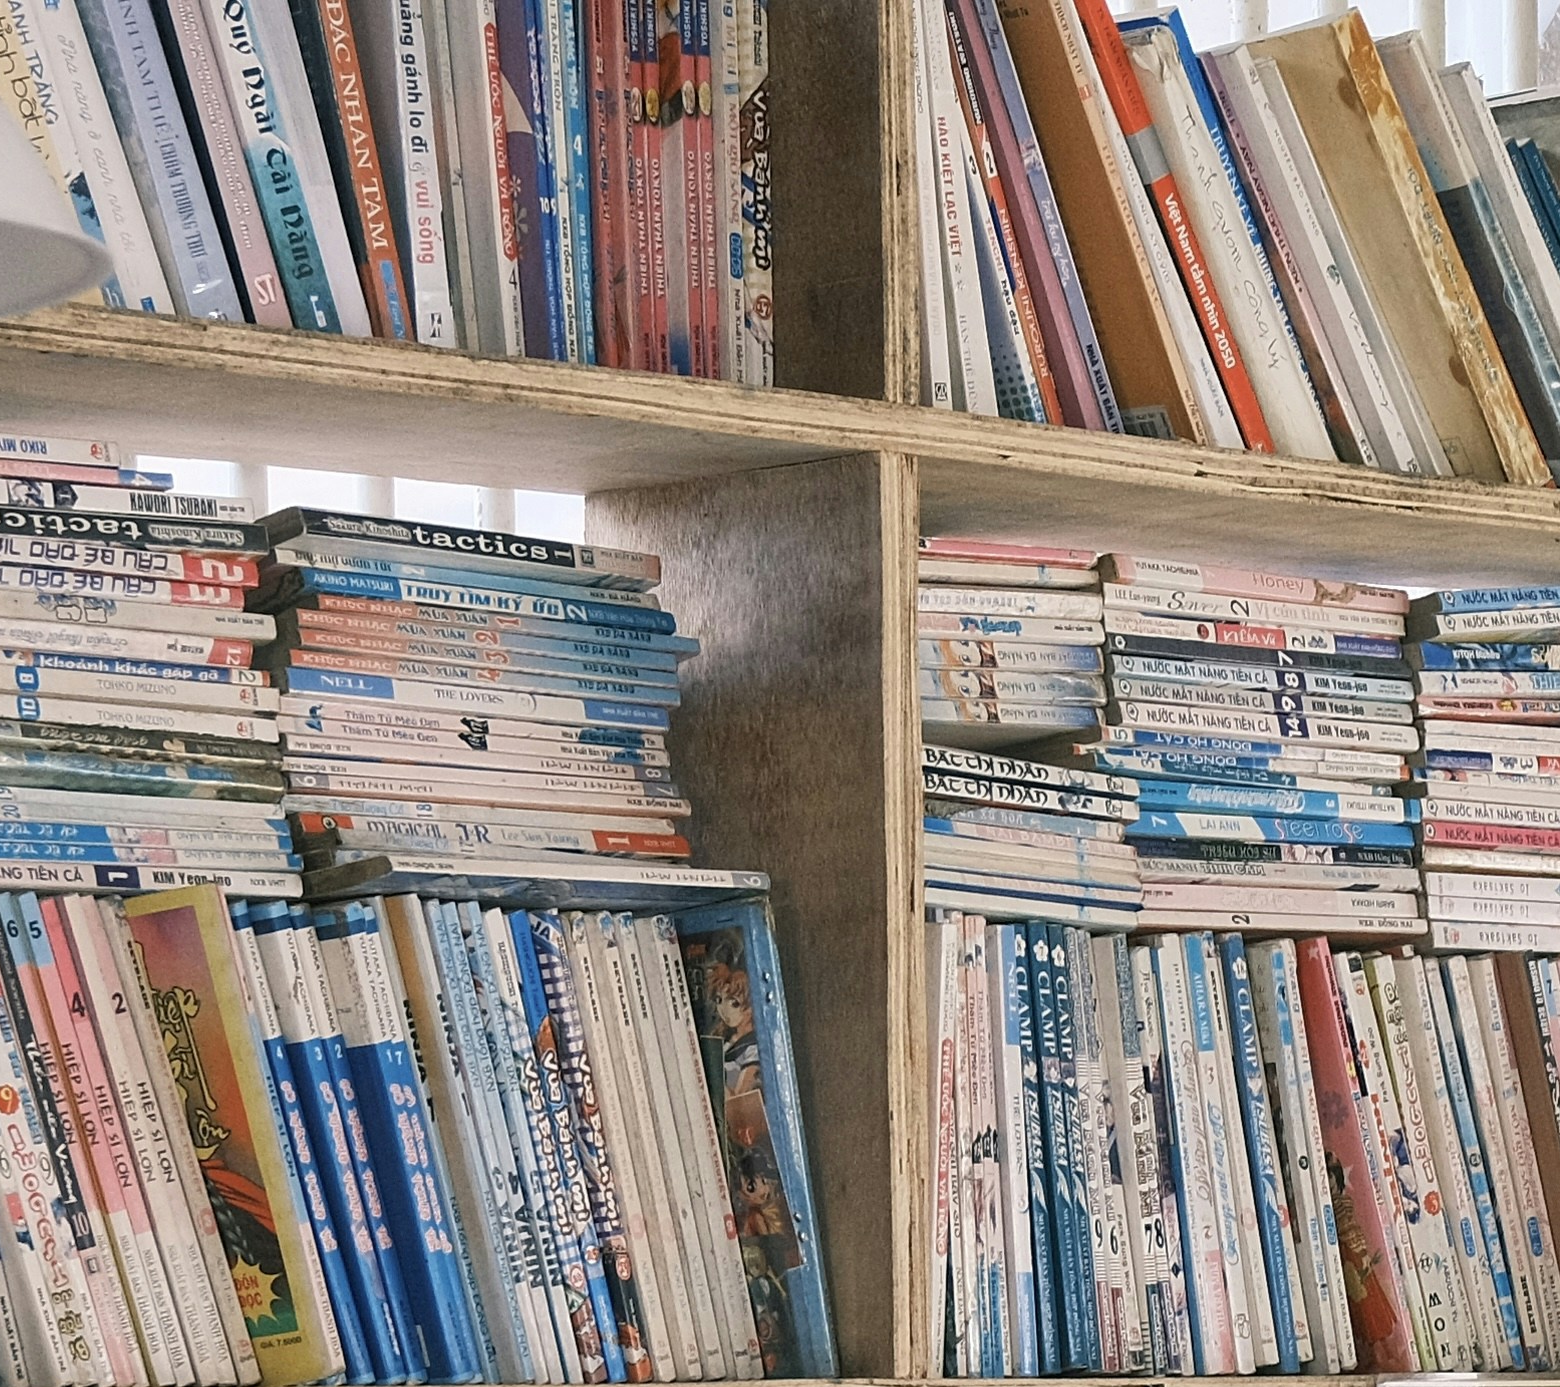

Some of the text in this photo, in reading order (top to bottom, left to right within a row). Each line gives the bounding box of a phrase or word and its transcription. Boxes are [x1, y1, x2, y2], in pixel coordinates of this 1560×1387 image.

[400, 53, 429, 154] gánh lo đi
[413, 180, 441, 264] vui sống
[1164, 192, 1183, 225] Việt
[1175, 224, 1195, 265] Nam
[1214, 330, 1236, 370] 2050
[412, 525, 549, 561] tactics
